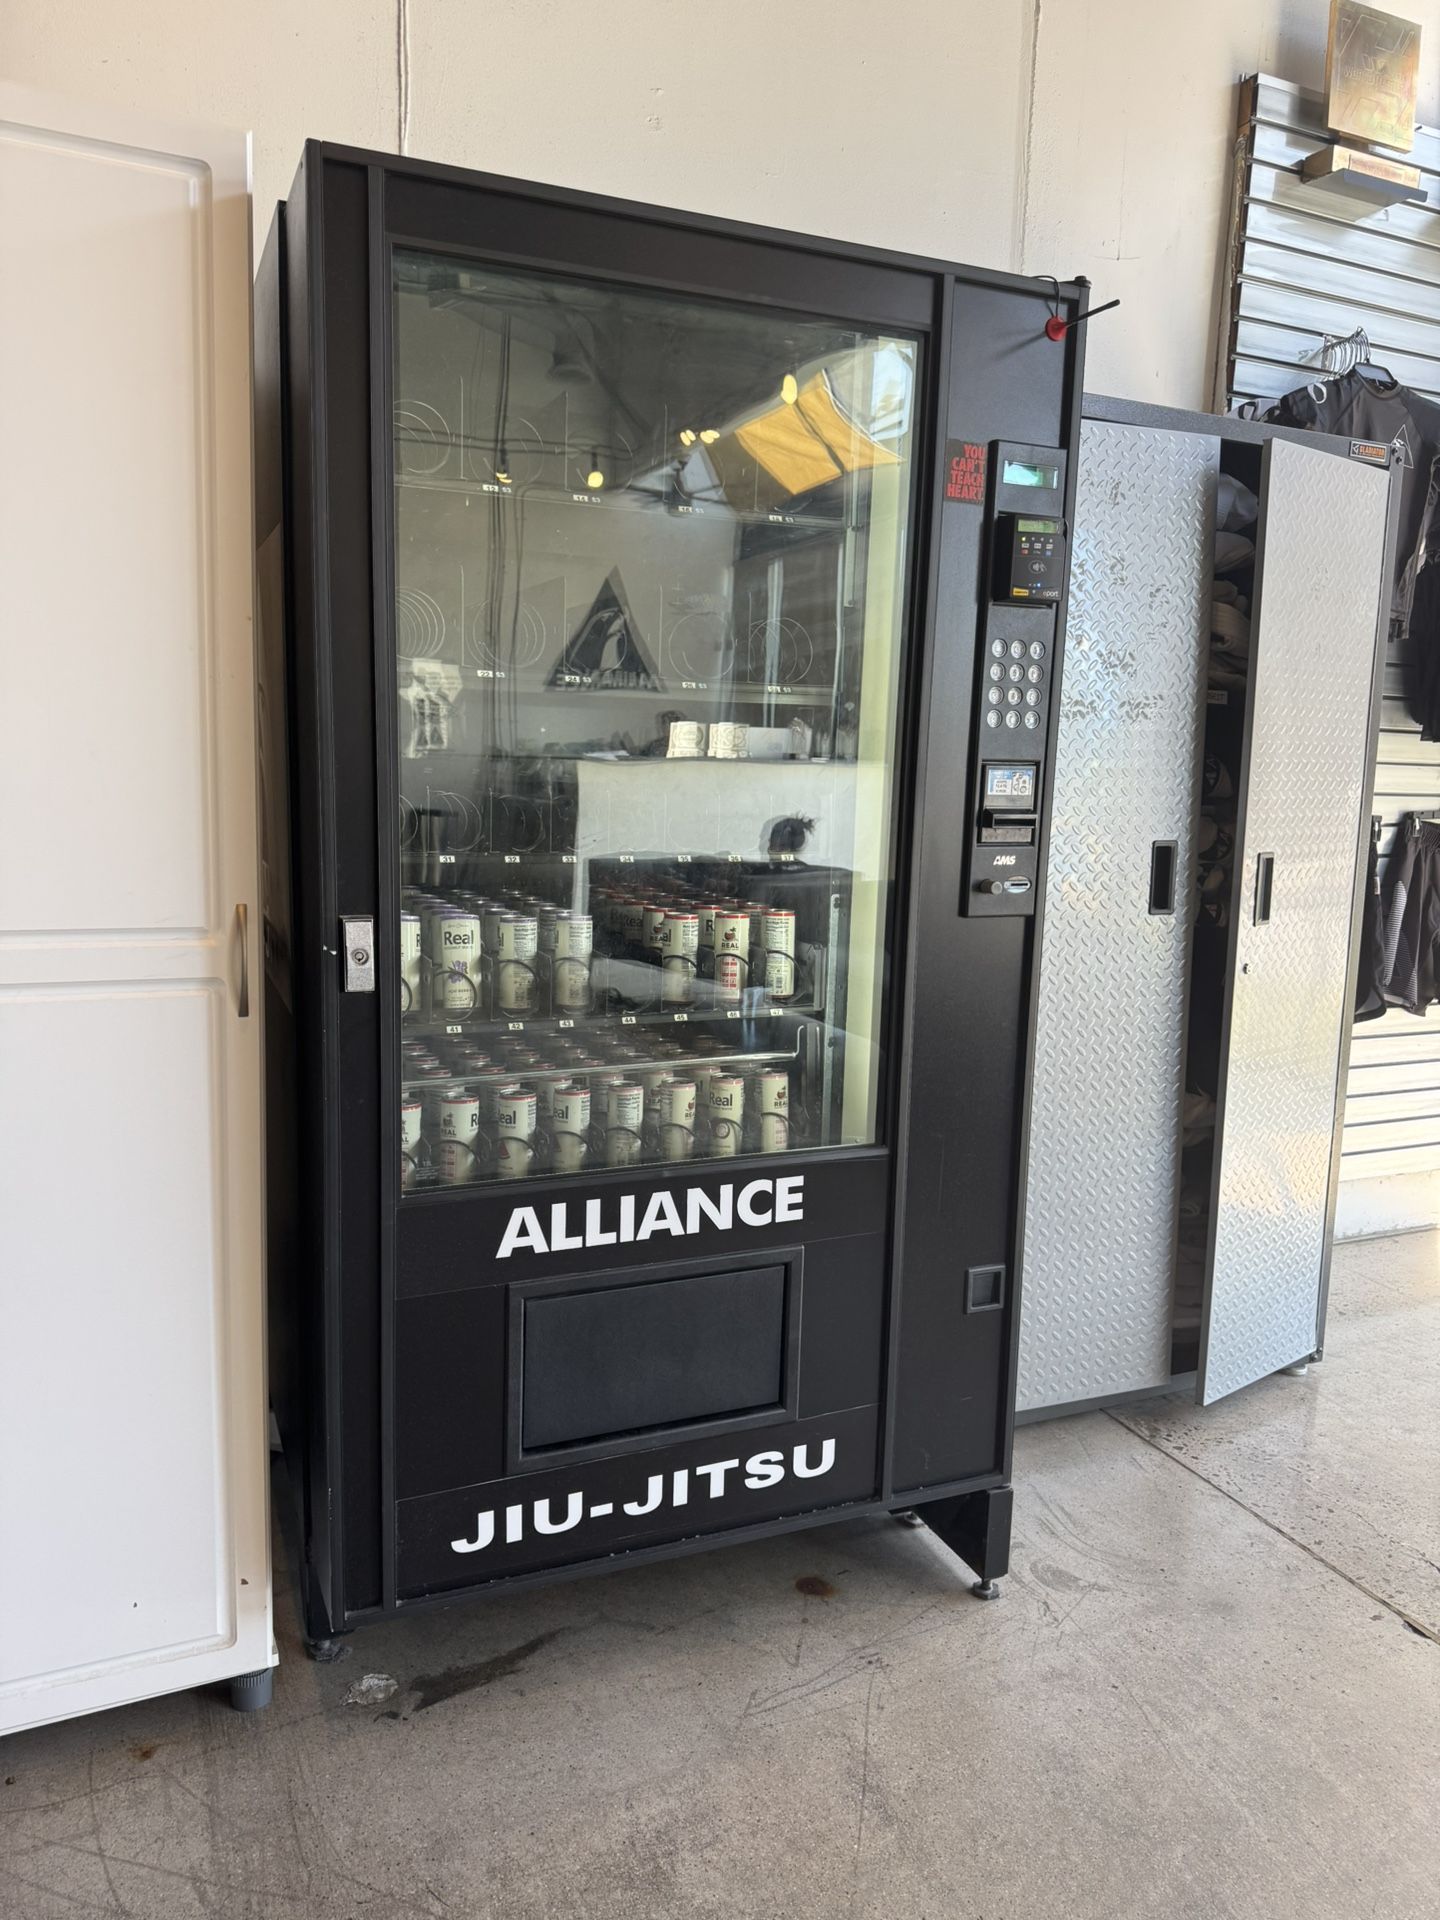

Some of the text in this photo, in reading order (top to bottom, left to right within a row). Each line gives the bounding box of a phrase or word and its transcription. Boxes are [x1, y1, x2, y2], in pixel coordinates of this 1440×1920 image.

[963, 443, 986, 459] YOU
[951, 456, 985, 473] CAN'T
[950, 470, 985, 487] TEACH
[993, 855, 1016, 866] AMS
[443, 930, 474, 946] Real
[709, 1092, 733, 1107] Real
[495, 1175, 805, 1259] ALLIANCE
[450, 1438, 836, 1554] JIU-JITSU
